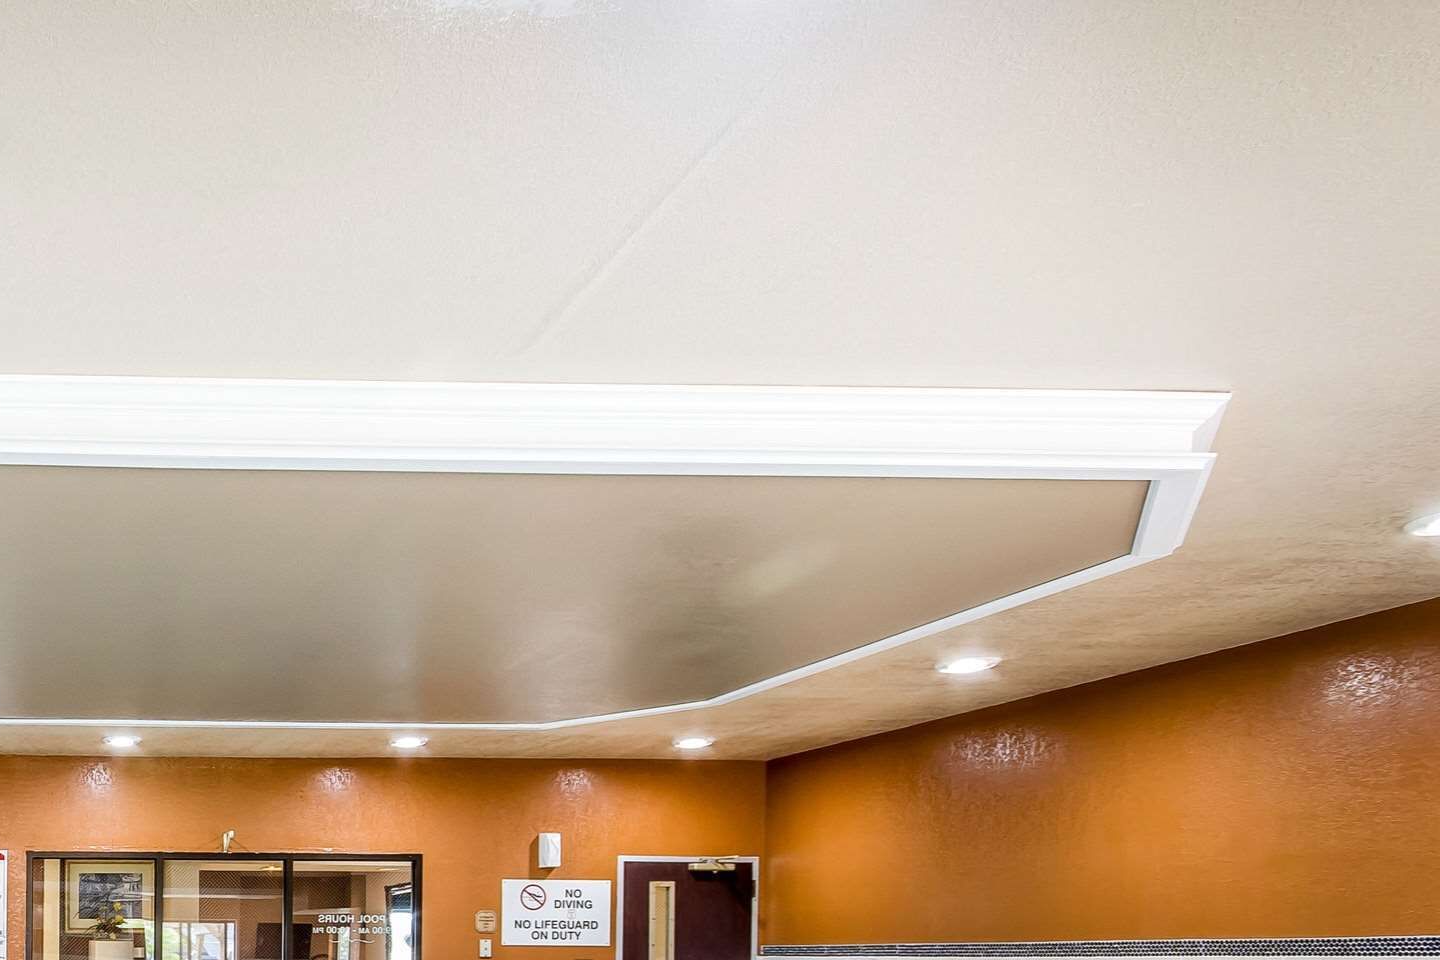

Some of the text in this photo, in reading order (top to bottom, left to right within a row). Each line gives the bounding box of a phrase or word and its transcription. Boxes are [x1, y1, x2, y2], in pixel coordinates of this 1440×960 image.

[565, 889, 582, 898] NO
[554, 900, 593, 909] DIVING
[514, 920, 599, 929] NO LIFEGUARD
[531, 931, 581, 940] ON DUTY
